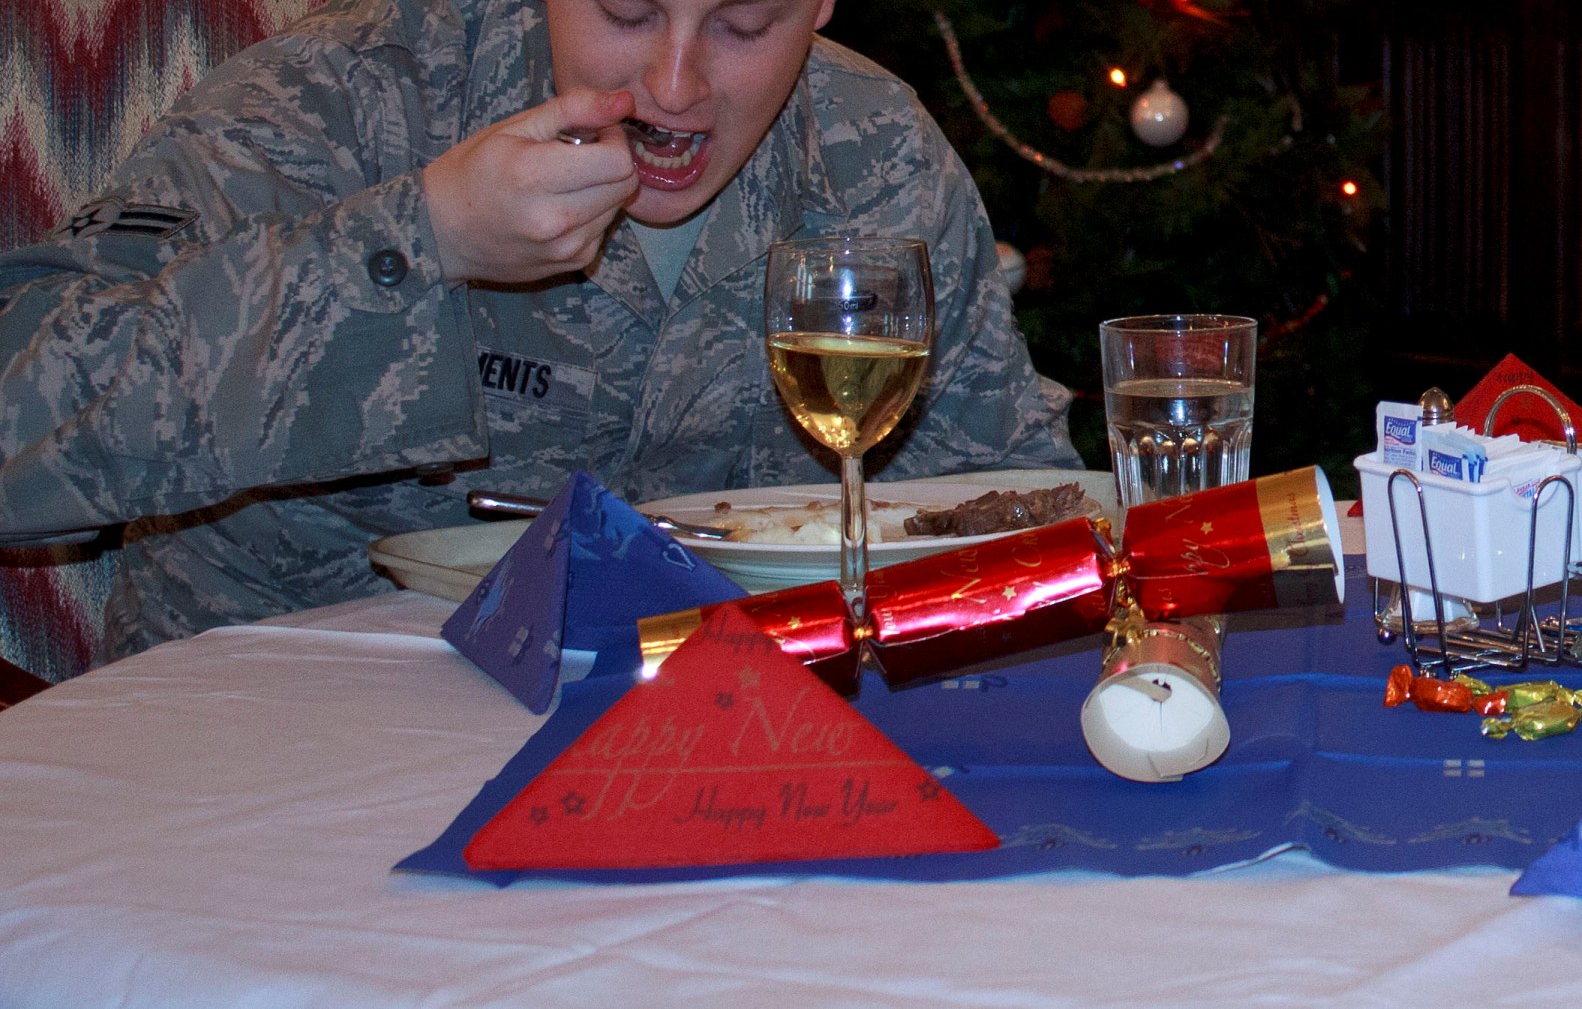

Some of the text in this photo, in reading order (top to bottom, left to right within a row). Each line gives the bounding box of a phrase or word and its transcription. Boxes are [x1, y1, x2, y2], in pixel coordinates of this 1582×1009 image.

[1385, 421, 1412, 439] Equal
[1430, 456, 1459, 474] Equal
[571, 713, 706, 822] appy
